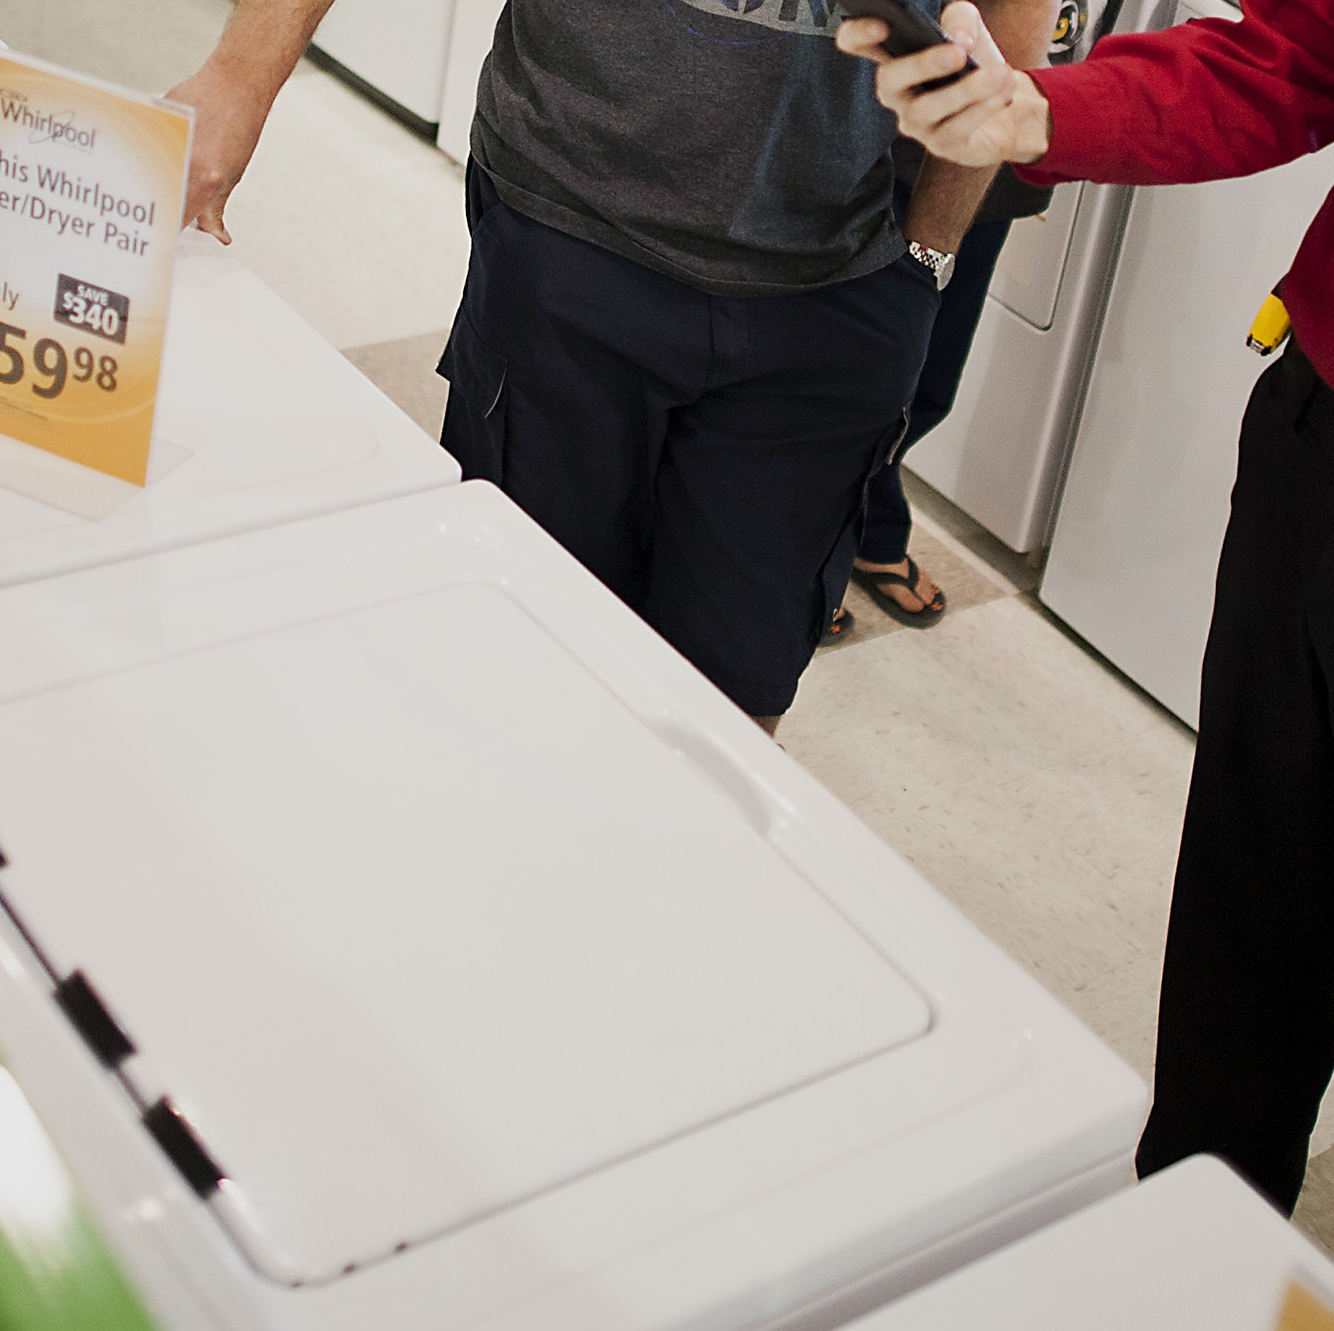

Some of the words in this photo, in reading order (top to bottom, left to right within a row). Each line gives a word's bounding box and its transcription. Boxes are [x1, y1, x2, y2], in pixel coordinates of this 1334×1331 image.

[0, 97, 97, 148] Whirlpool
[36, 165, 157, 227] Whirlpool
[104, 222, 150, 257] Pair
[63, 291, 119, 337] $340
[77, 284, 110, 306] SAVE
